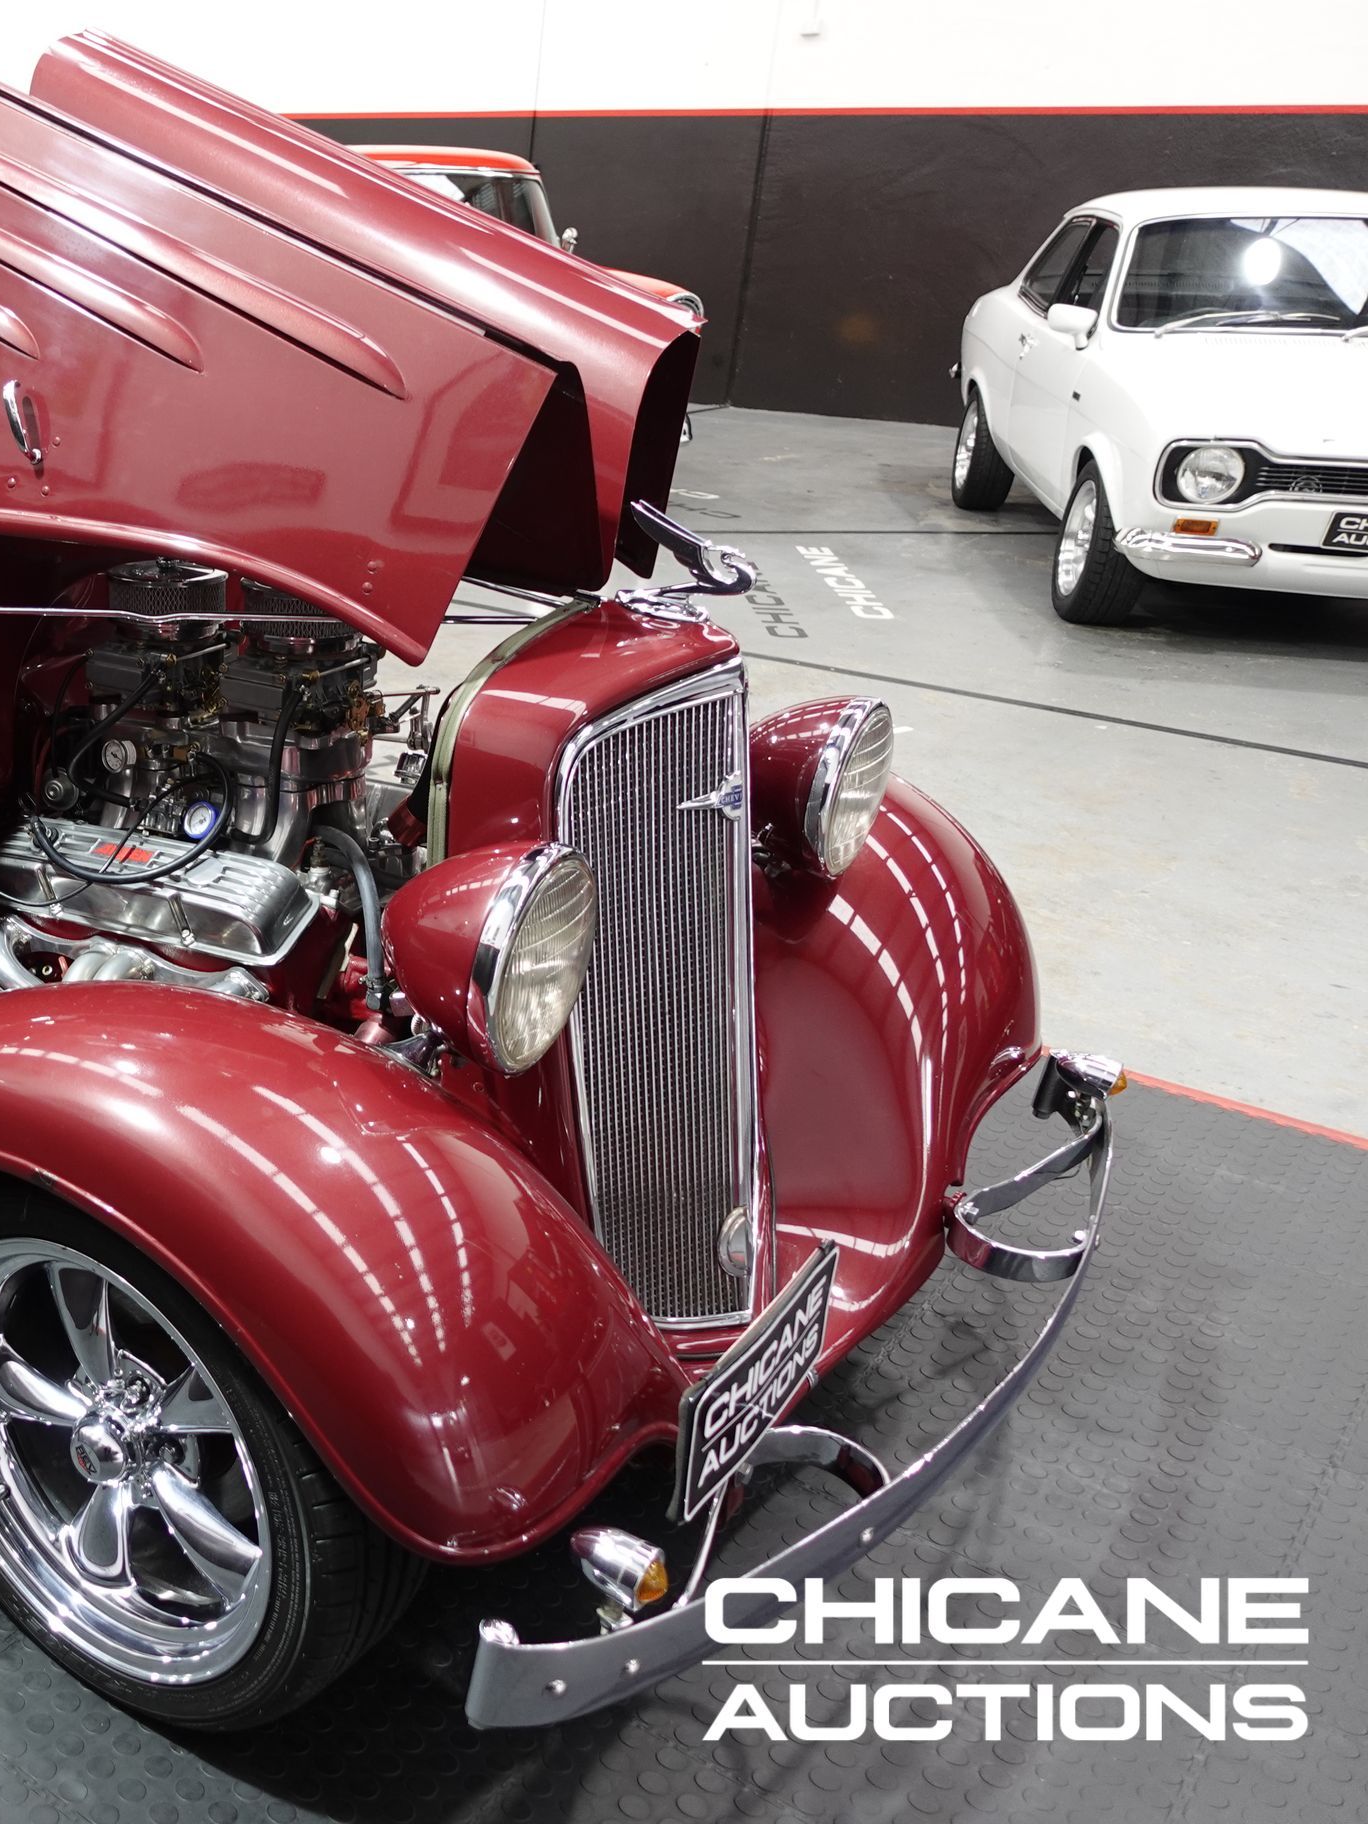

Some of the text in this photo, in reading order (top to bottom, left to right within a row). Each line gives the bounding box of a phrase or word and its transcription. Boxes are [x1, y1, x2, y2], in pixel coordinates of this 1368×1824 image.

[1332, 532, 1368, 546] AU
[746, 561, 809, 639] CHICA
[795, 545, 895, 620] CHICANE
[703, 1274, 826, 1439] CHICANE
[697, 1322, 820, 1488] AUCTIONS
